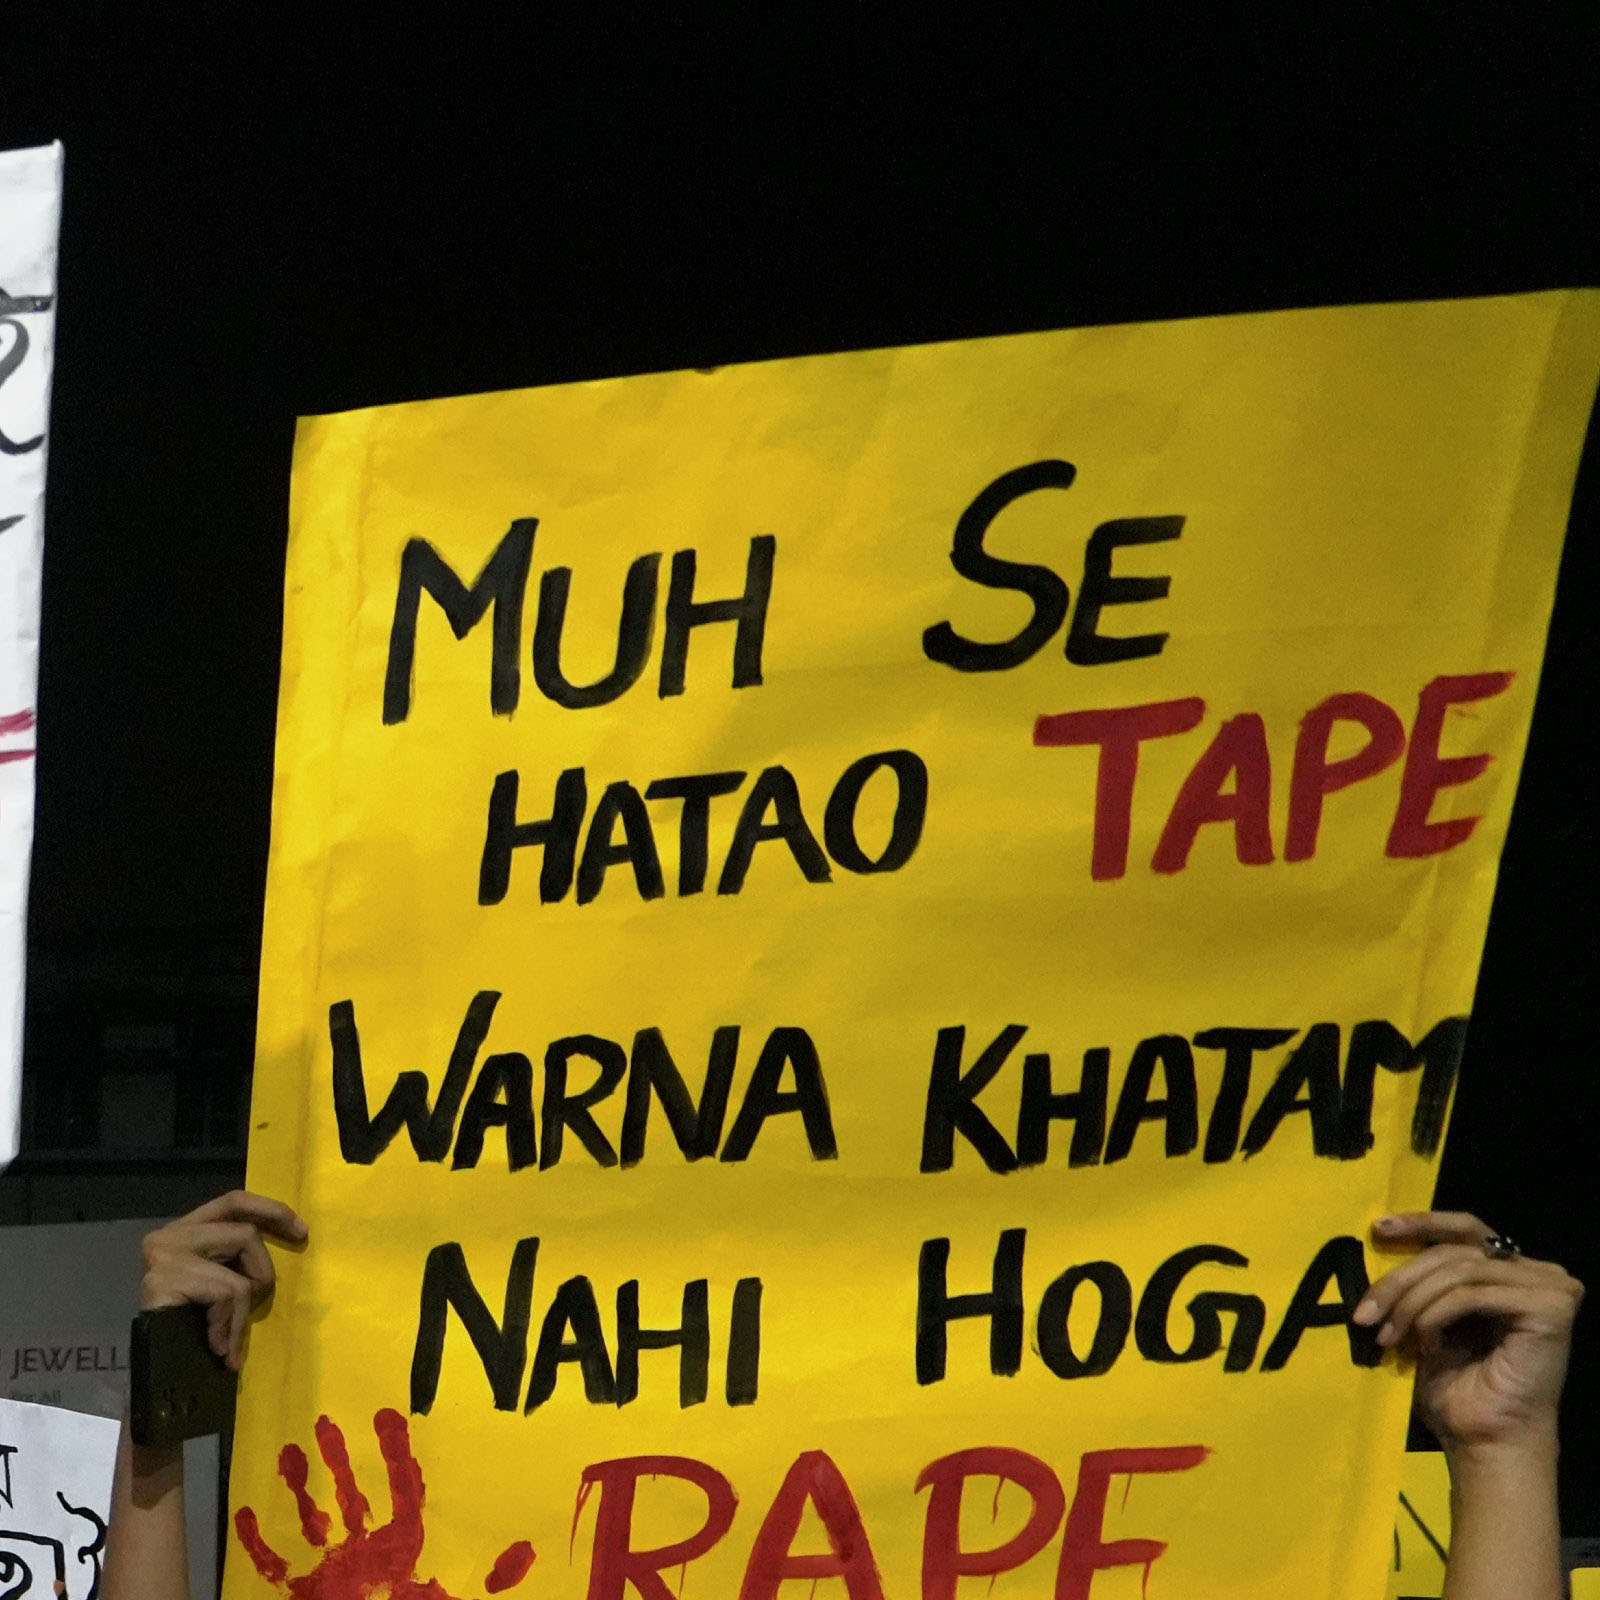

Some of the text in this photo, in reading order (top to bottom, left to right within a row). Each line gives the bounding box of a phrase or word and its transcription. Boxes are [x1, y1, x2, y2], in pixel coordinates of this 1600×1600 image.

[382, 458, 1189, 725] MUH SE
[477, 670, 1520, 907] HATAO TAPE
[326, 988, 1473, 1175] WARNA KHATAM
[9, 1346, 131, 1380] JEWELL
[408, 1228, 1385, 1415] NAHI HOGA
